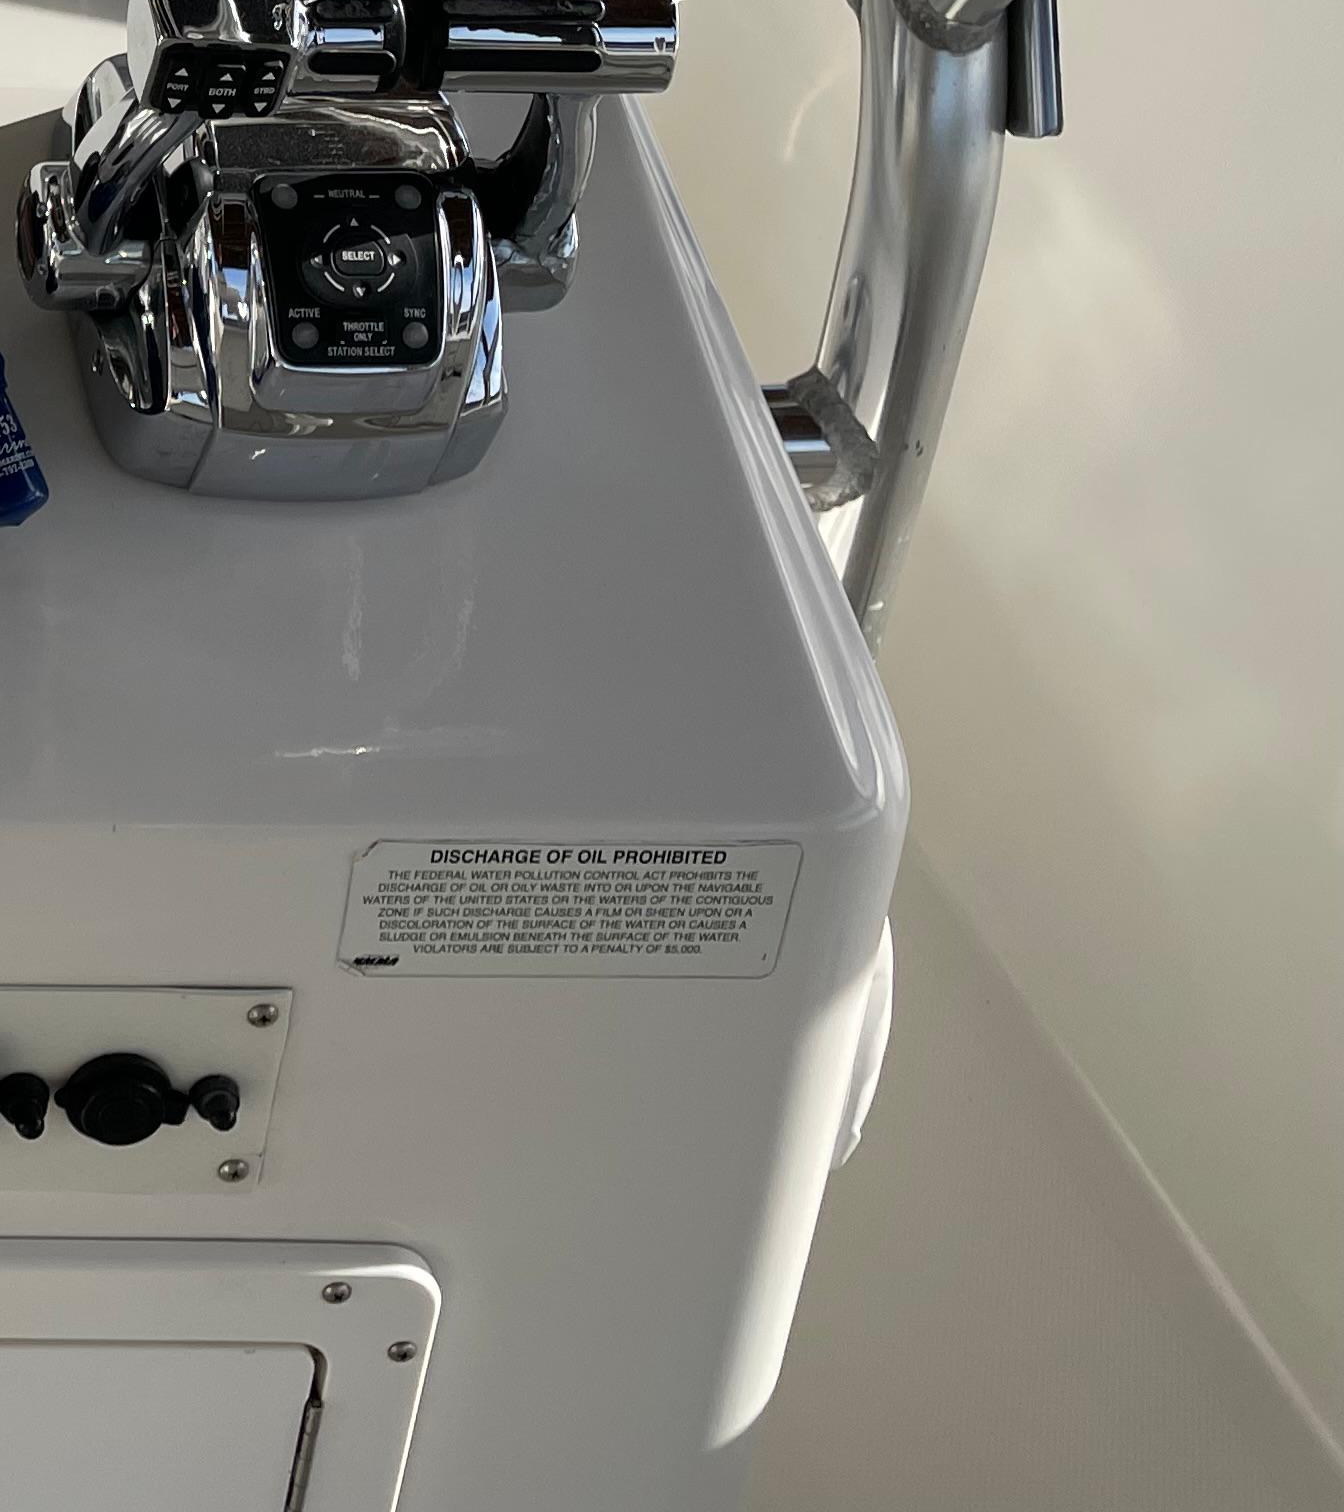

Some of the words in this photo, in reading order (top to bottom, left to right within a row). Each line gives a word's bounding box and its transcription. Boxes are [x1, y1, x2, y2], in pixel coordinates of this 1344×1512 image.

[166, 82, 189, 91] PORT
[208, 88, 237, 97] BOTH
[327, 189, 366, 199] NEUTRAL
[341, 250, 375, 261] SELECT
[288, 307, 321, 318] ACTIVE
[403, 307, 426, 319] SYNC
[342, 321, 385, 332] THROTTLE
[353, 332, 373, 342] ONLY
[327, 346, 363, 357] STATION
[364, 346, 396, 357] SELECT
[431, 850, 541, 864] DISCHARGE
[547, 850, 574, 865] OF
[578, 850, 607, 865] OIL
[613, 850, 728, 865] PROHIBITED
[389, 871, 411, 880] THE
[414, 871, 467, 880] FEDERAL
[471, 871, 511, 880] WATER
[514, 871, 581, 880] POLLUTION
[583, 871, 639, 880] CONTROL
[643, 871, 666, 880] ACT
[669, 871, 732, 880] PROHIBITS
[736, 871, 759, 880] THE
[378, 883, 447, 893] DISCHARGE
[450, 883, 467, 893] OF
[469, 883, 487, 893] OIL
[491, 883, 509, 893] OR
[512, 883, 538, 893] OILY
[540, 883, 580, 893] WASTE
[584, 883, 611, 893] INTO
[615, 883, 632, 893] OR
[636, 883, 669, 893] UPON
[672, 883, 695, 893] THE
[698, 883, 763, 893] NAVIGABLE
[363, 896, 410, 905] WATERS
[414, 896, 429, 905] OF
[434, 896, 456, 905] THE
[459, 896, 502, 905] UNITED
[505, 896, 549, 905] STATES
[552, 896, 569, 905] OR
[573, 896, 596, 905] THE
[599, 896, 647, 905] WATERS
[650, 896, 667, 905] OF
[670, 896, 692, 905] THE
[696, 896, 774, 905] CONTIGUOUS
[377, 908, 410, 918] ZONE
[413, 908, 423, 918] IF
[427, 908, 460, 918] SUCH
[463, 908, 531, 918] DISCHARGE
[534, 908, 582, 918] CAUSES
[595, 908, 622, 918] FILM
[625, 908, 642, 918] OR
[645, 908, 685, 918] SHEEN
[689, 908, 722, 918] UPON
[725, 908, 742, 918] OR
[380, 920, 474, 930] DISCOLORATION
[477, 920, 493, 930] OF
[497, 920, 518, 930] THE
[522, 920, 576, 930] SURFACE
[580, 920, 596, 930] OF
[600, 920, 623, 930] THE
[626, 920, 665, 930] WATER
[669, 920, 686, 930] OR
[689, 920, 736, 930] CAUSES
[379, 932, 426, 942] SLUDGE
[430, 932, 447, 942] OR
[450, 932, 510, 942] EMULSION
[513, 932, 567, 942] BENEATH
[571, 933, 593, 942] THE
[596, 933, 650, 942] SURFACE
[653, 933, 670, 942] OF
[674, 933, 695, 942] THE
[413, 944, 477, 954] VIOLATORS
[482, 944, 504, 954] ARE
[508, 944, 560, 954] SUBJECT
[563, 945, 578, 954] TO
[591, 945, 643, 954] PENALTY
[646, 945, 662, 954] OF
